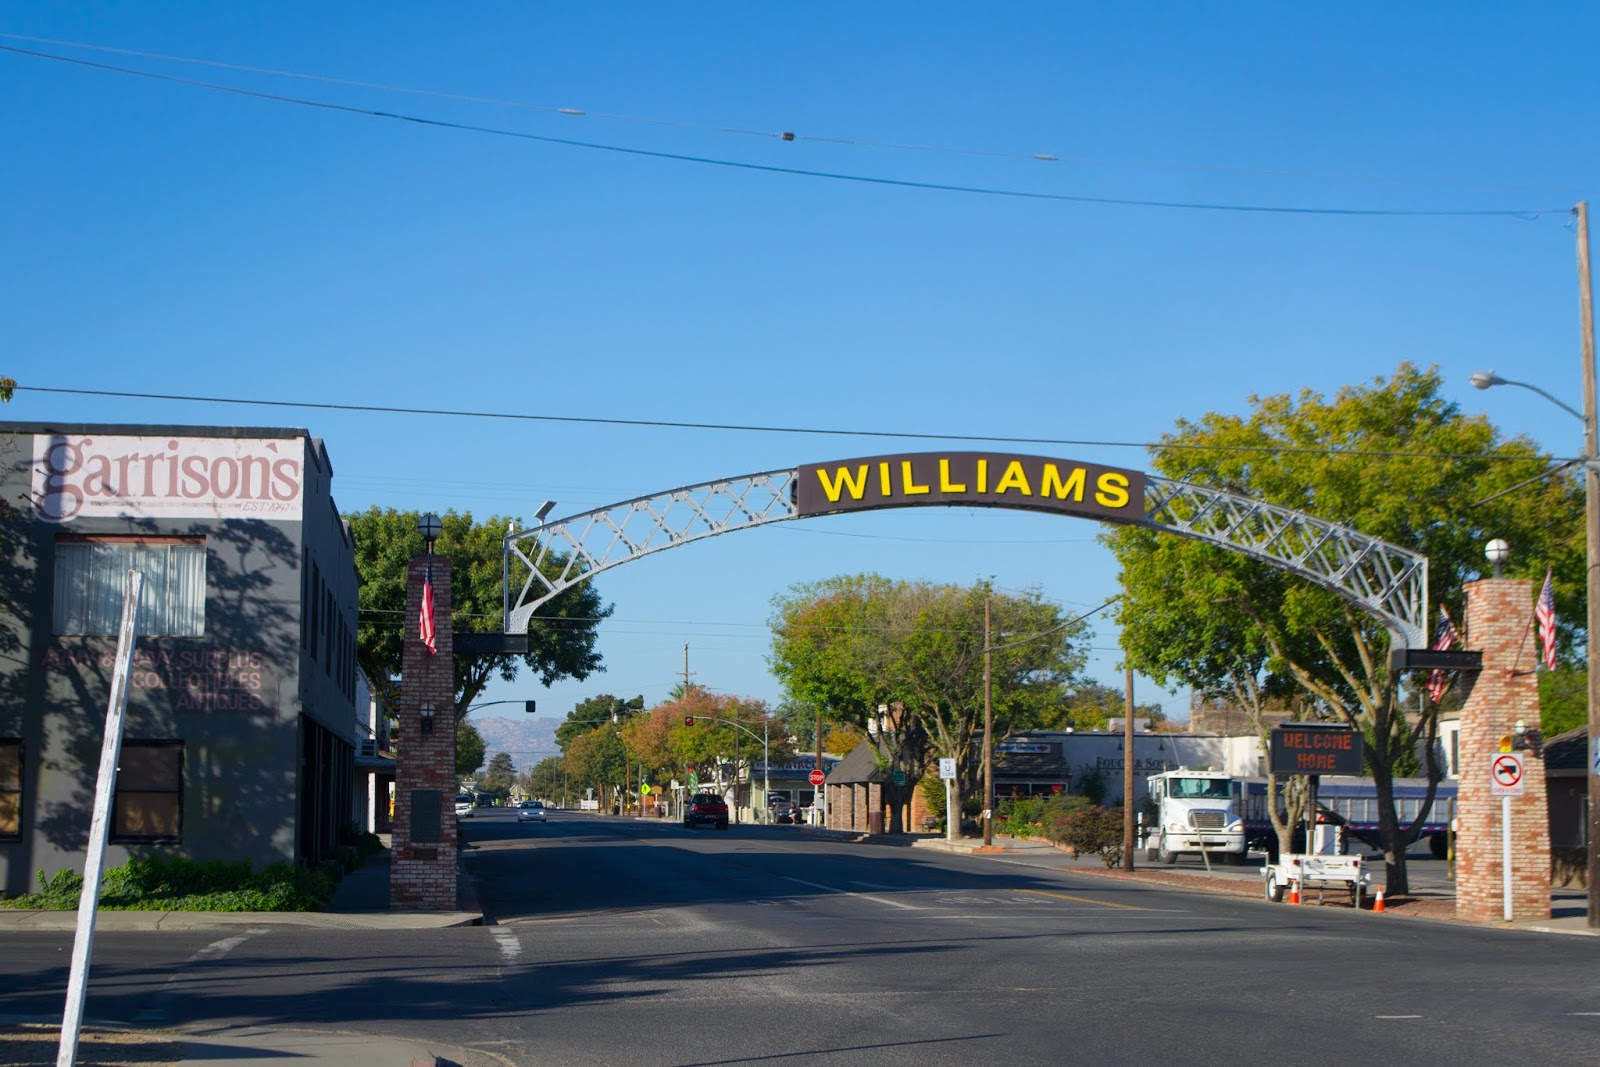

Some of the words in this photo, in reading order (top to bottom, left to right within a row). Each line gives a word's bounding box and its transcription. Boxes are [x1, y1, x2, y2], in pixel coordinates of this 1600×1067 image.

[34, 438, 300, 520] garrison's
[816, 459, 1130, 508] WILLIAMS
[181, 651, 262, 669] SURPLUS
[131, 671, 261, 690] COLLECTIBLES
[175, 692, 261, 711] ANTIQUES
[1283, 733, 1352, 750] WELCOME
[1096, 756, 1125, 769] FOUC
[1296, 753, 1337, 769] HOME
